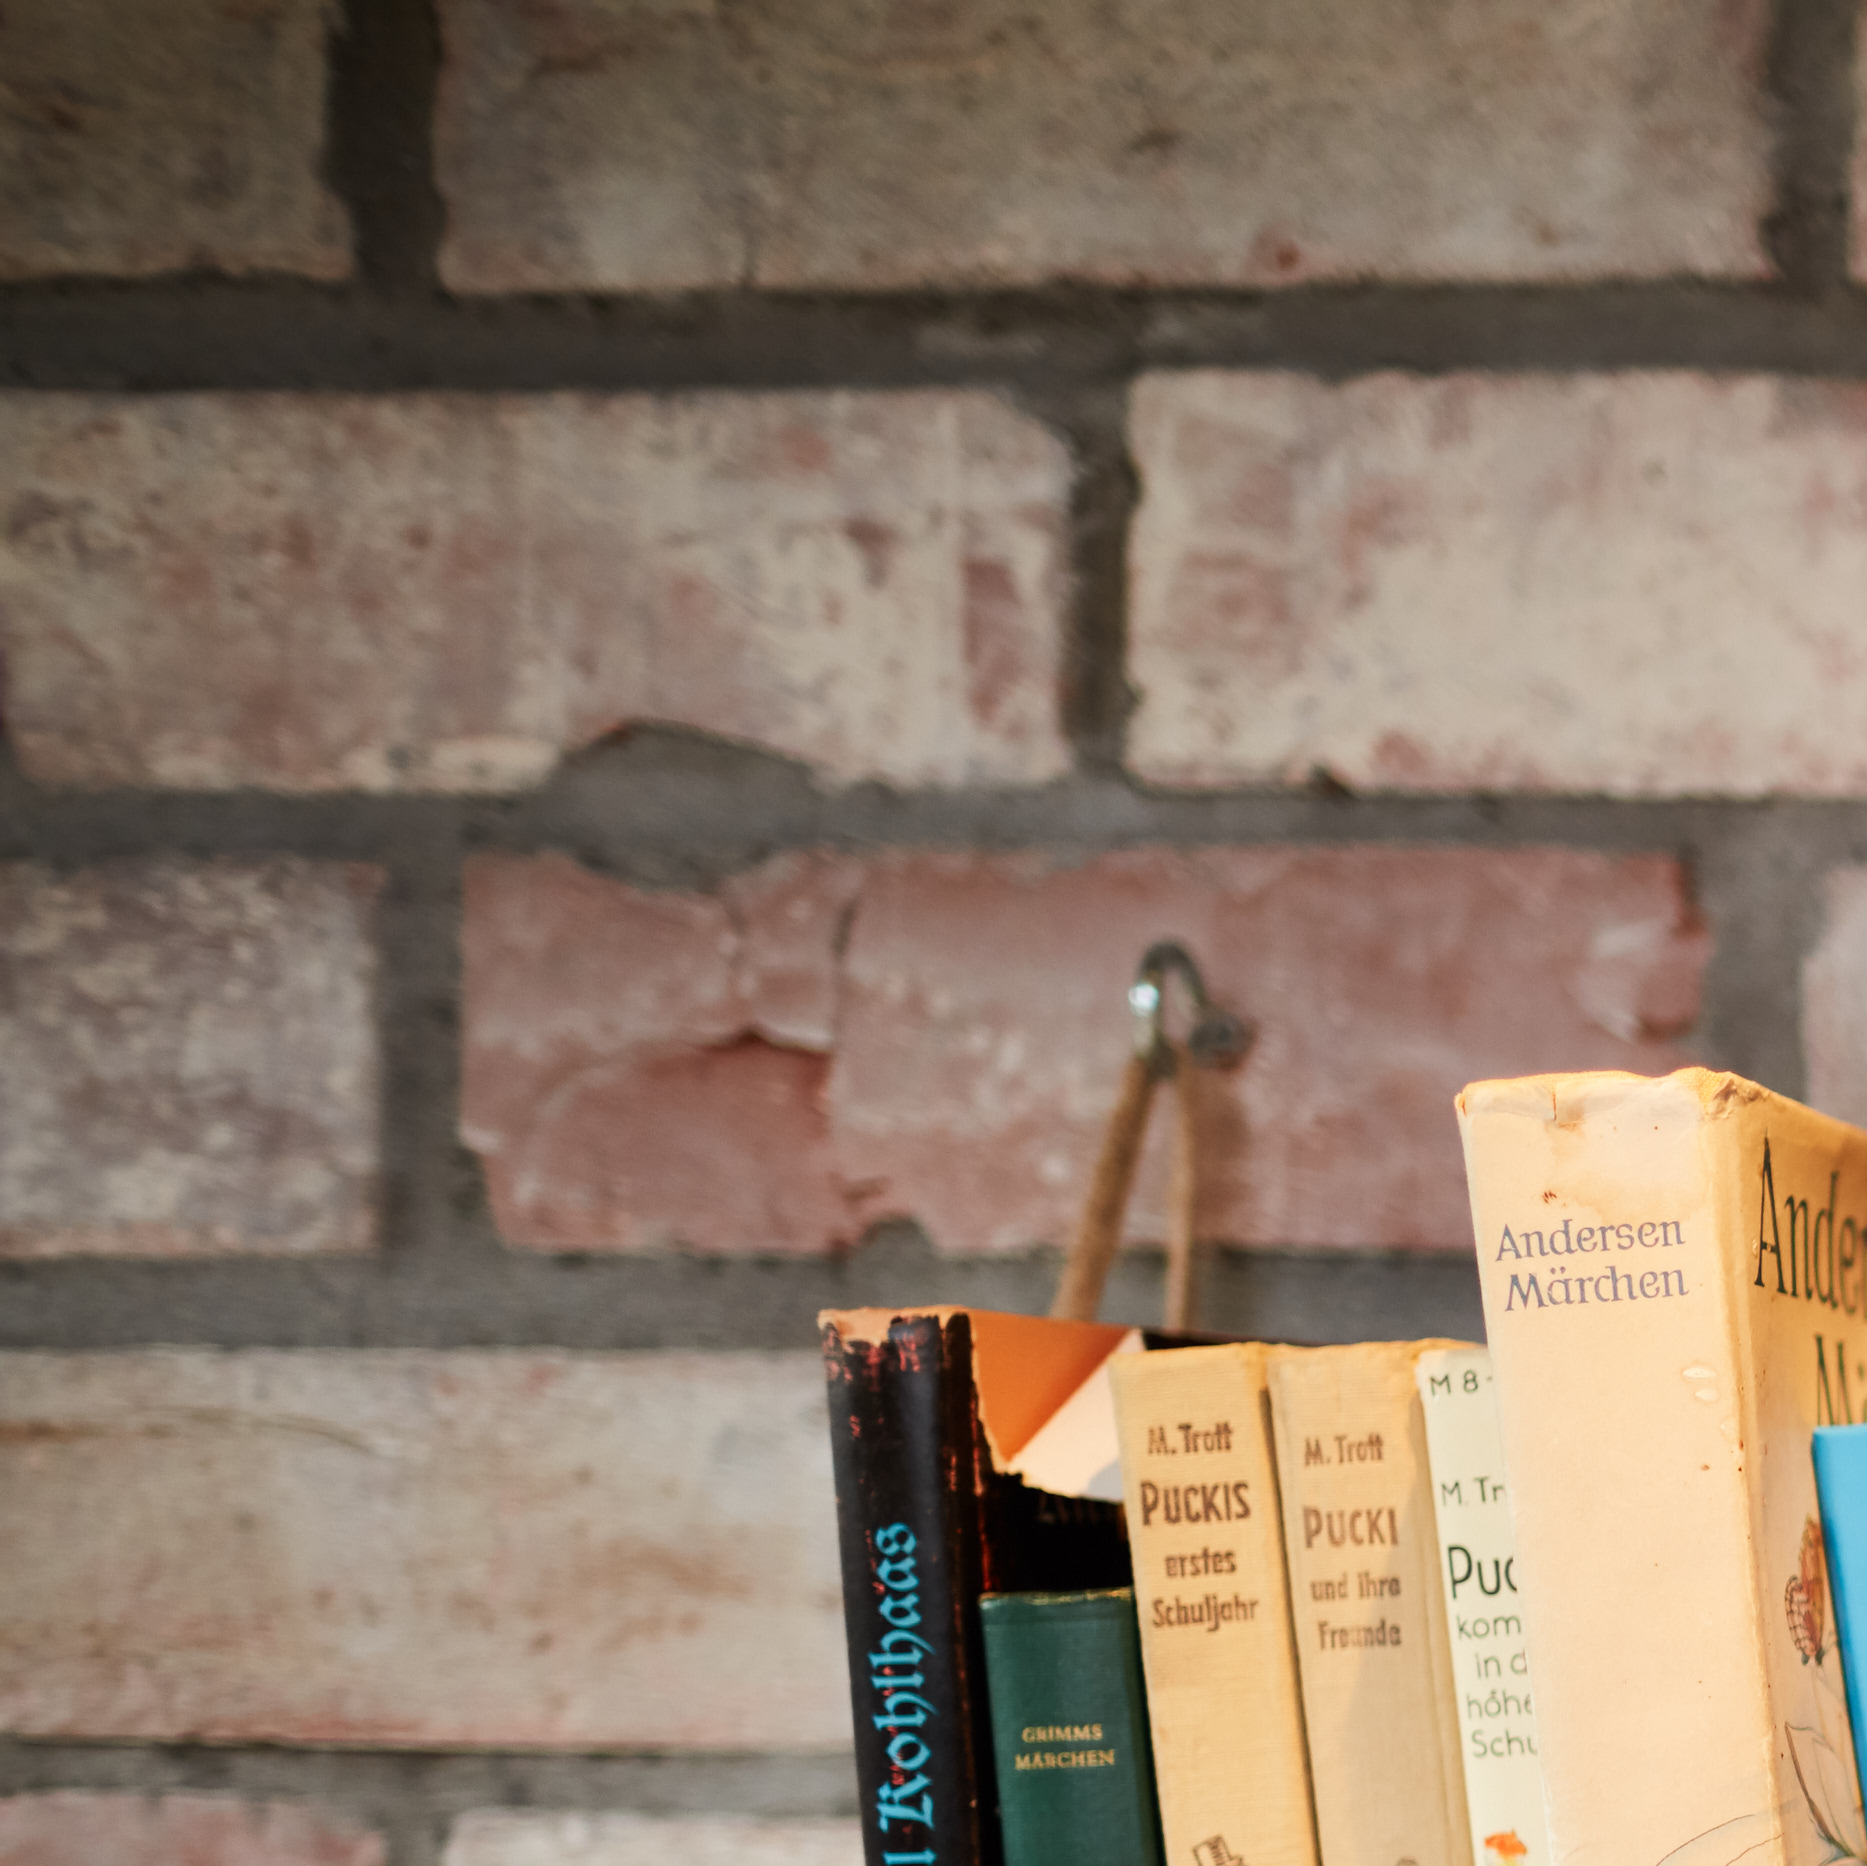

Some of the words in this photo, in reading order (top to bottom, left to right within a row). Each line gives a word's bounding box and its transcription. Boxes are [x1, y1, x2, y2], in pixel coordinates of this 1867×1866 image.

[1495, 1216, 1687, 1264] Andersen
[1504, 1265, 1690, 1313] Märchen
[1429, 1373, 1452, 1397] M
[1461, 1368, 1480, 1394] 8
[1147, 1424, 1177, 1455] M.
[1178, 1421, 1233, 1453] Trott
[1303, 1436, 1332, 1468] M.
[1334, 1432, 1384, 1464] Trott
[1140, 1480, 1251, 1526] PUCKIS
[1303, 1505, 1399, 1548] PUCKI
[1164, 1546, 1238, 1578] erstes
[1310, 1572, 1348, 1601] und
[1151, 1592, 1259, 1632] Schuljahr
[867, 1522, 938, 1833] Kohlhaas
[1022, 1723, 1103, 1742] GRIMMS
